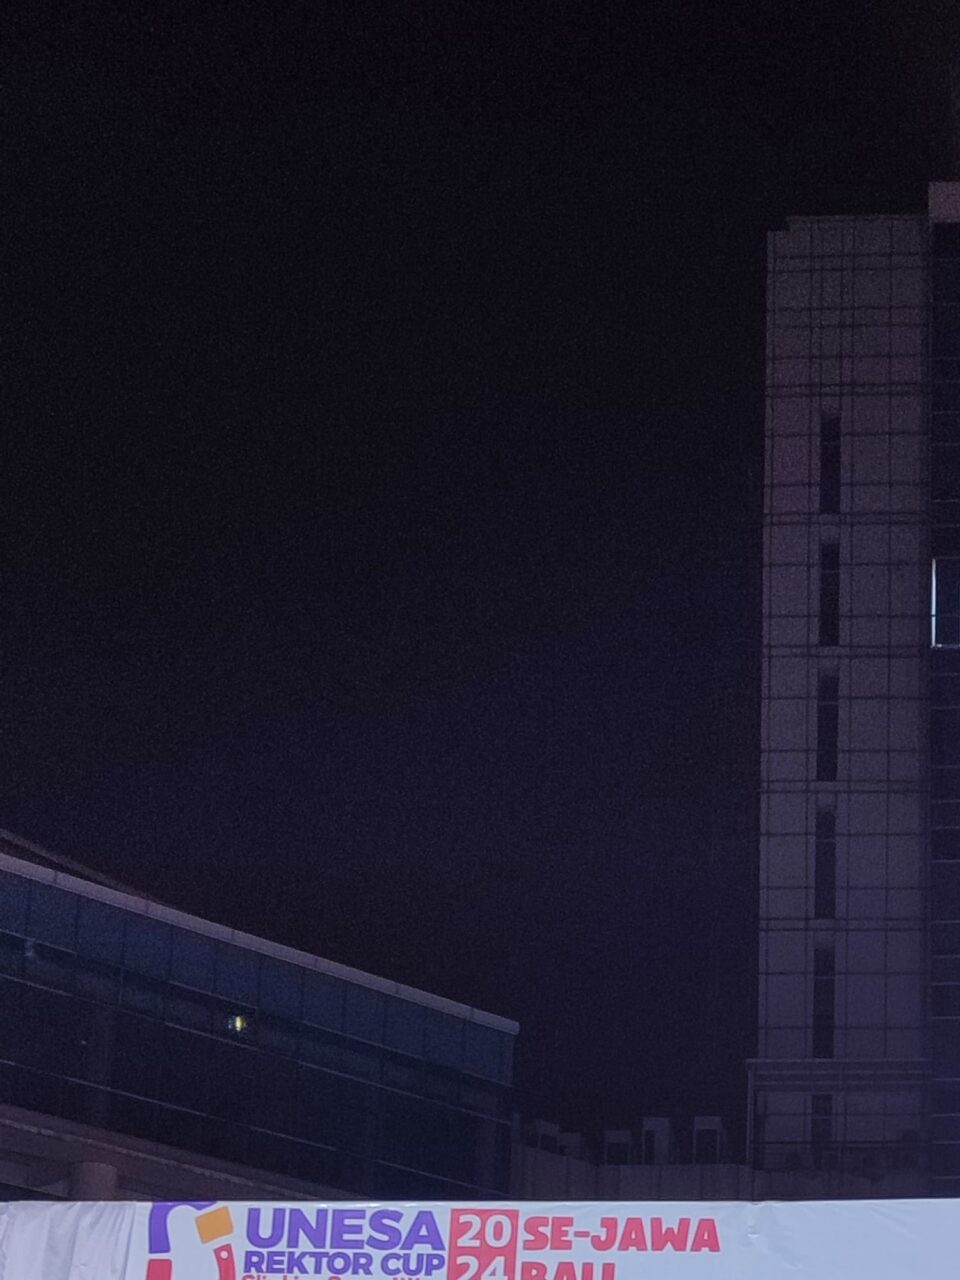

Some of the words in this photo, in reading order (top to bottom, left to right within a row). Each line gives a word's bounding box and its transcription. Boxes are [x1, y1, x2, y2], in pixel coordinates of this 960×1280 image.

[246, 1207, 446, 1250] UNESA
[456, 1213, 513, 1248] 20
[522, 1216, 721, 1252] SE-JAWA
[243, 1250, 374, 1275] REKTOR
[380, 1253, 446, 1277] CUP
